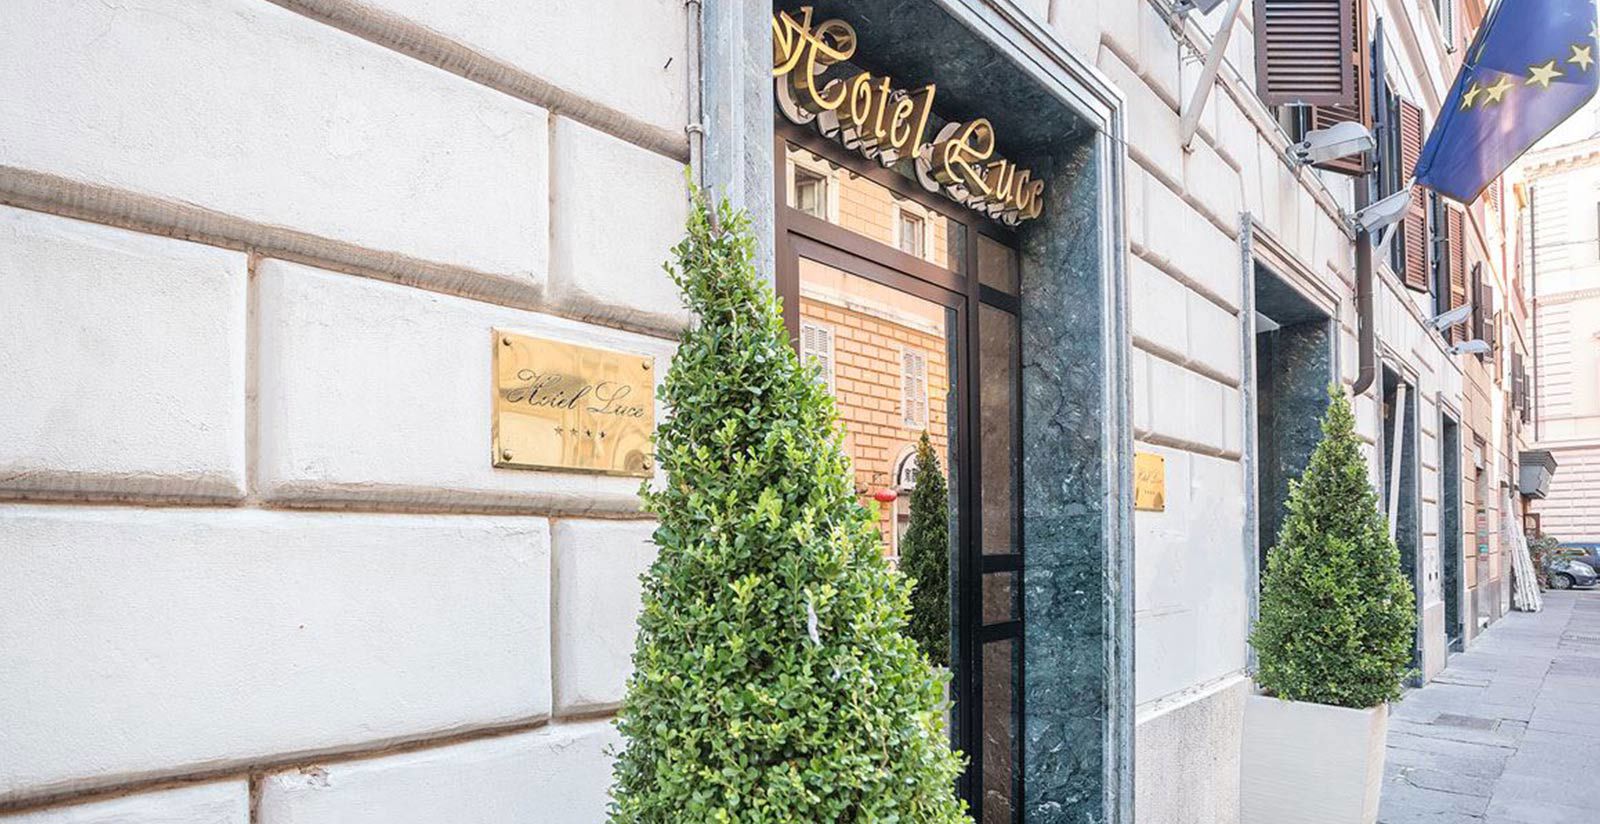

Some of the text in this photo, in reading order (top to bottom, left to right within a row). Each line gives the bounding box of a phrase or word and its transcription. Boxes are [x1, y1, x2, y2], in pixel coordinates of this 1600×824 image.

[772, 6, 1044, 219] Hotel Luce
[505, 368, 645, 419] Hotel Luce
